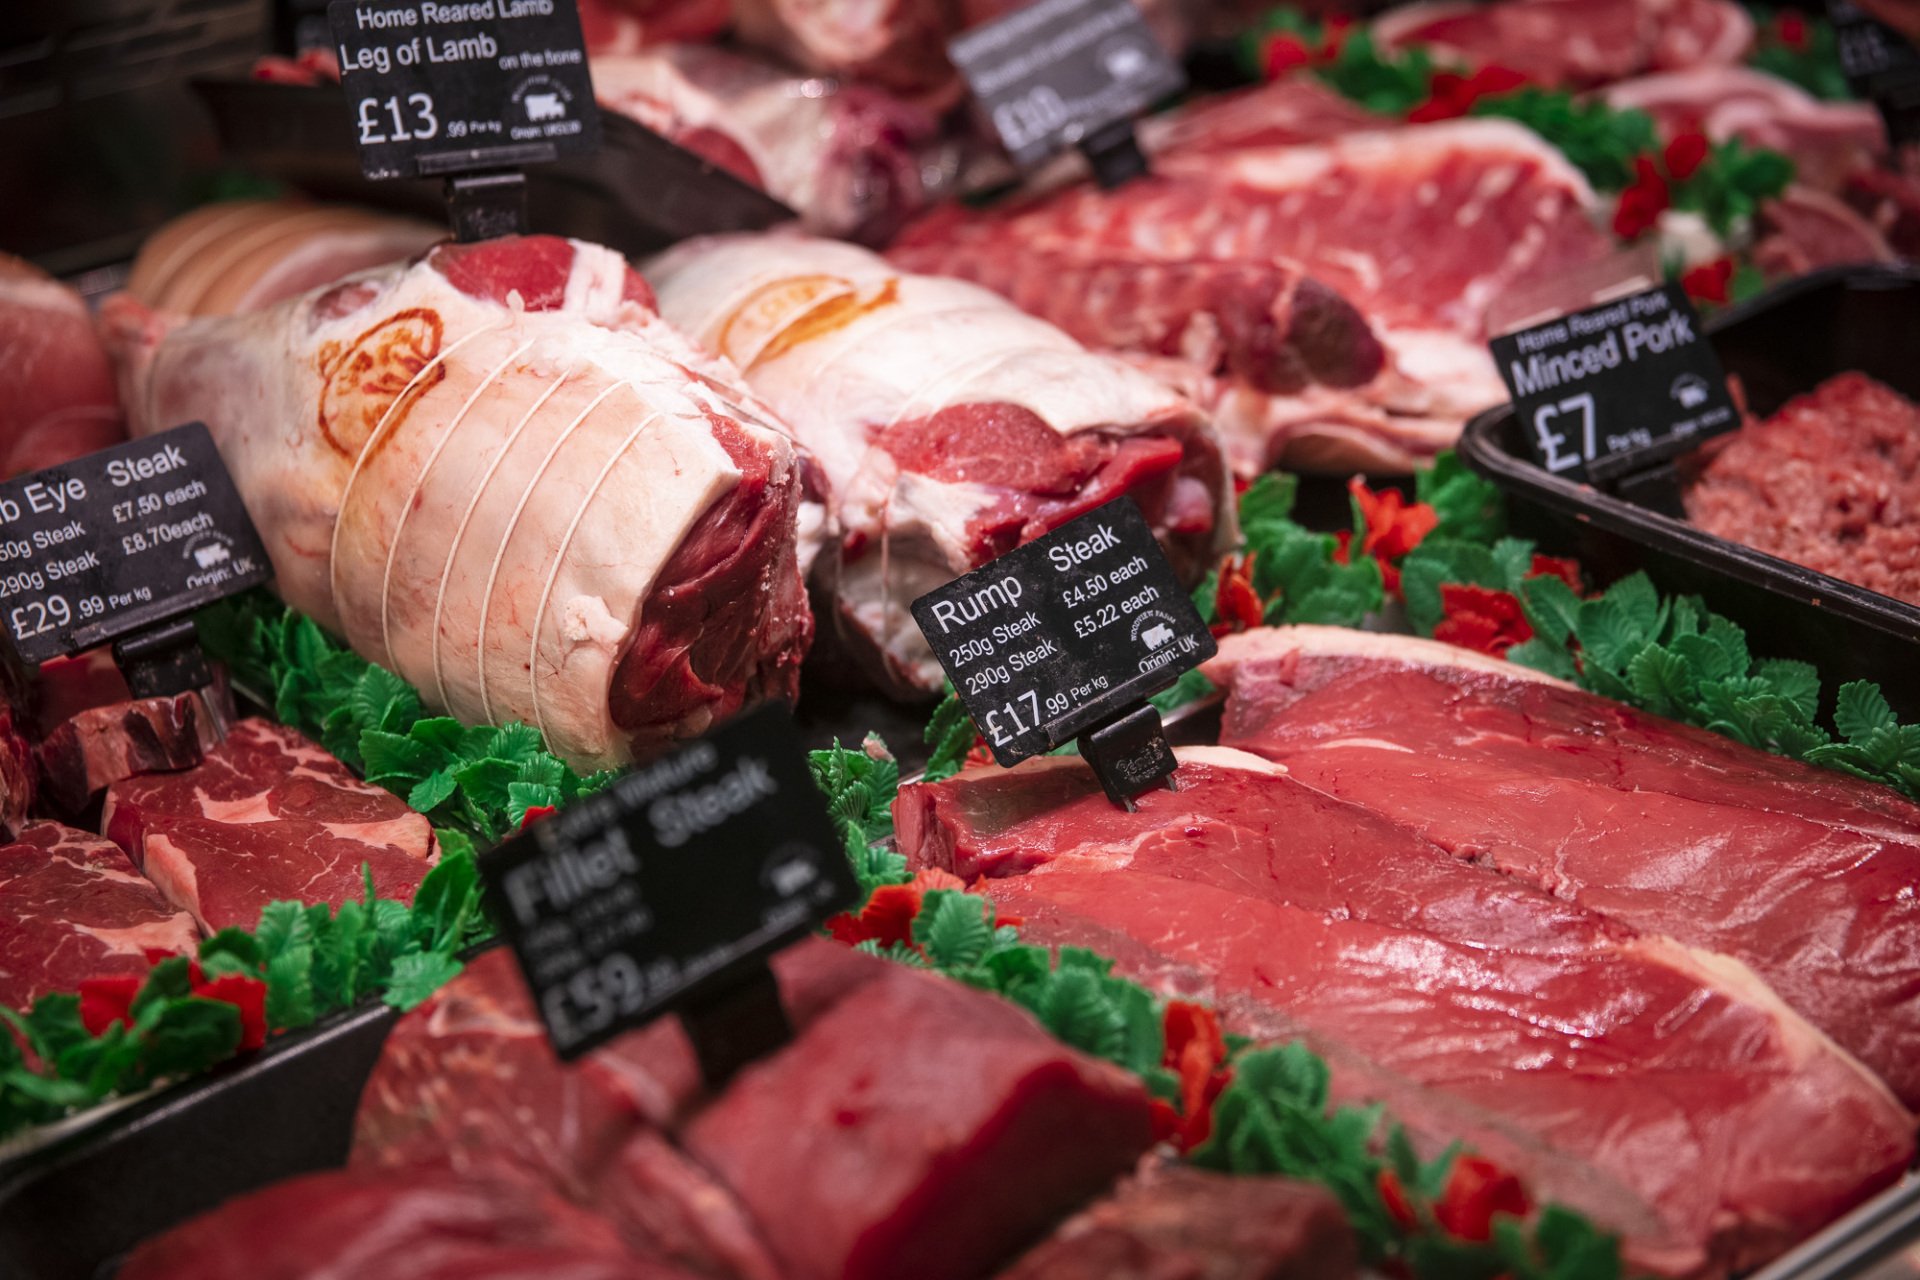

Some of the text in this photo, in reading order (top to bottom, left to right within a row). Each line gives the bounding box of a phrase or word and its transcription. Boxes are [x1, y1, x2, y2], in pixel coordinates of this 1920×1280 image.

[356, 0, 554, 30] Home Reared Lamb
[340, 33, 497, 74] Leg of Lamb
[499, 55, 520, 70] on
[522, 52, 543, 68] the
[357, 92, 439, 145] £13
[1517, 291, 1670, 354] Home Reared Pork
[1511, 330, 1622, 397] Minced
[1622, 309, 1696, 362] Pork
[1533, 392, 1597, 472] £7
[24, 478, 87, 514] Eye
[106, 444, 188, 487] Steak
[112, 479, 207, 524] £7.50 each
[33, 520, 87, 549] Steak
[0, 550, 100, 598] 290g Steak
[108, 593, 132, 609] Per
[134, 586, 152, 602] kg
[930, 525, 1121, 635] Rump Steak
[1063, 556, 1148, 609] £4.50 each
[1074, 584, 1160, 639] £5.22 each
[949, 611, 1041, 668] 250g Steak
[1178, 634, 1200, 653] UK
[965, 639, 1058, 696] 290g Steak
[1070, 684, 1093, 701] Per
[1093, 674, 1109, 690] kg
